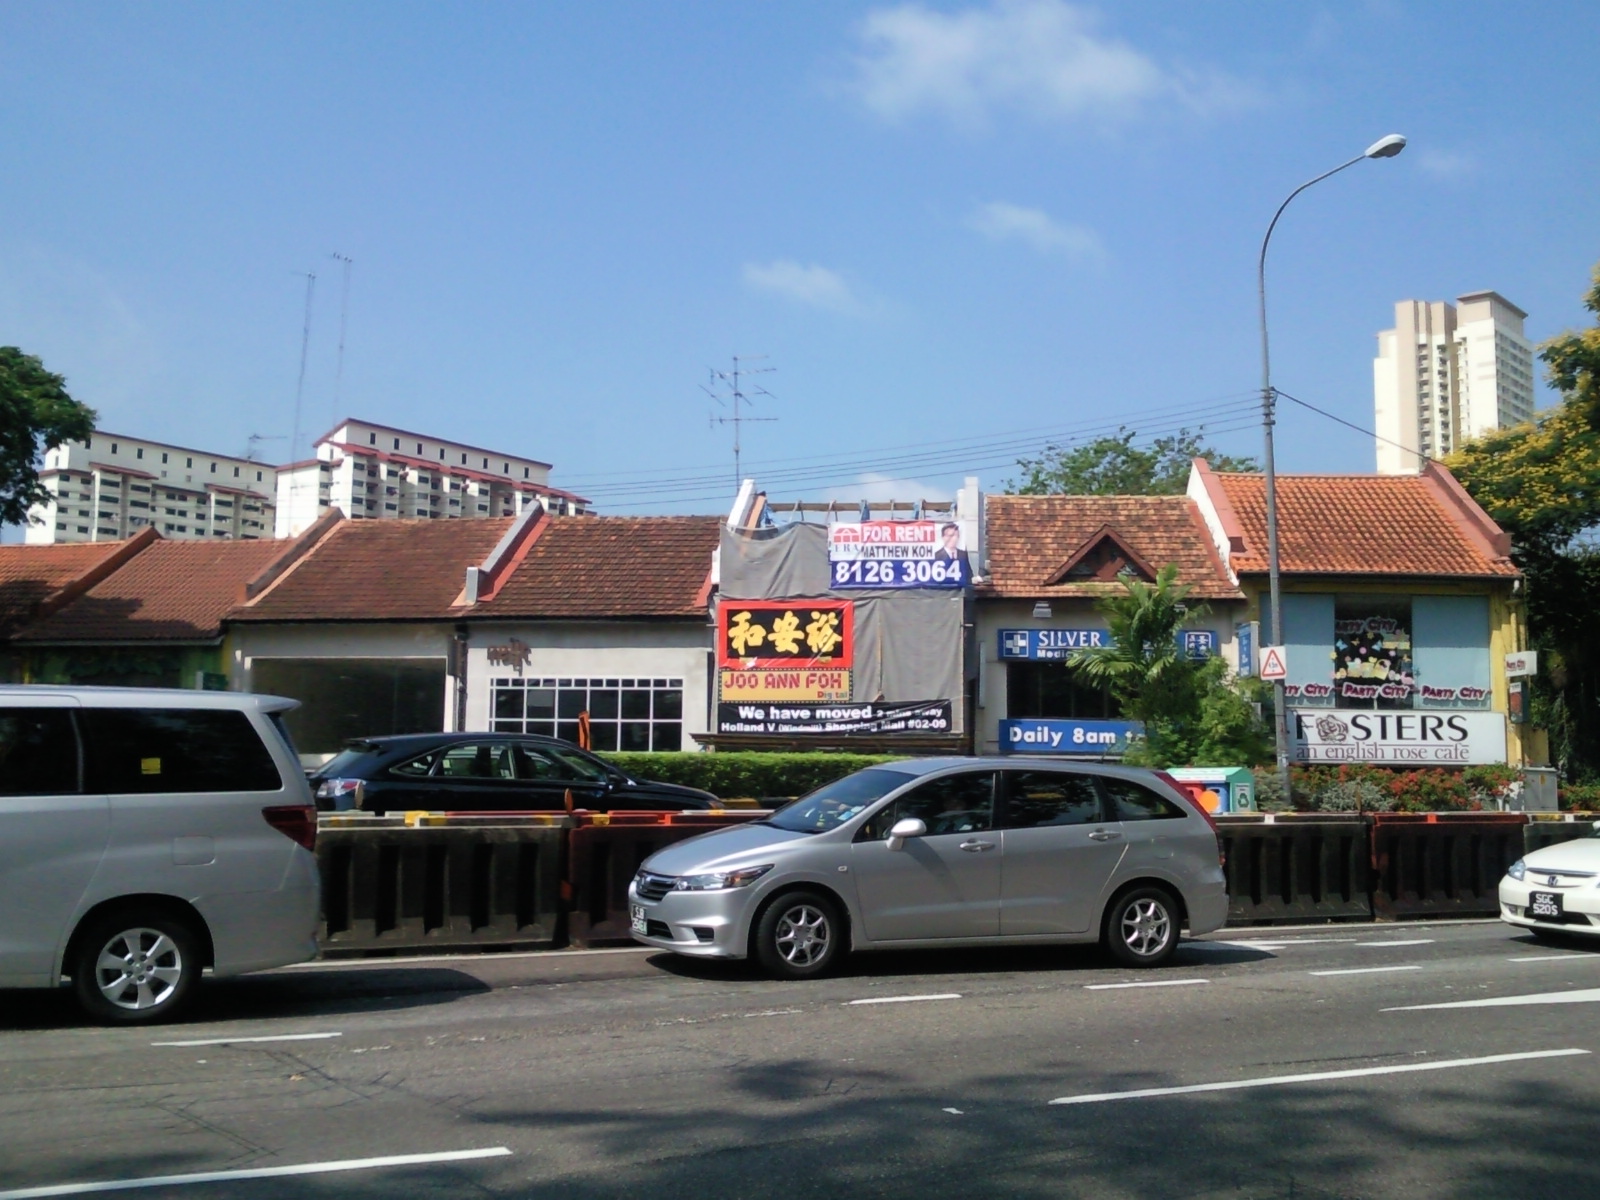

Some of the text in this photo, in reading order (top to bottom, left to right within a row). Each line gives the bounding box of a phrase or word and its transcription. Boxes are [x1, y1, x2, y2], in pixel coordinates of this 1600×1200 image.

[863, 526, 934, 542] FOR RENT
[863, 545, 933, 558] MATTHEW KOH
[836, 560, 962, 583] 8126 3064
[1038, 631, 1101, 647] SILVER
[724, 673, 842, 689] JOO ANN FOH
[817, 691, 847, 699] Digtal
[1304, 683, 1330, 695] CITY
[1344, 683, 1409, 697] PARTY CITY
[1421, 685, 1486, 698] PARTY CITY
[738, 705, 872, 719] We have moved
[721, 722, 764, 732] Holland
[767, 722, 775, 732] V
[825, 721, 877, 732] Shopping
[907, 719, 947, 729] #02-09
[1009, 726, 1064, 747] Daily
[1072, 727, 1116, 744] 8am
[1297, 747, 1318, 760] an
[1325, 742, 1384, 762] english
[1393, 747, 1428, 760] rose
